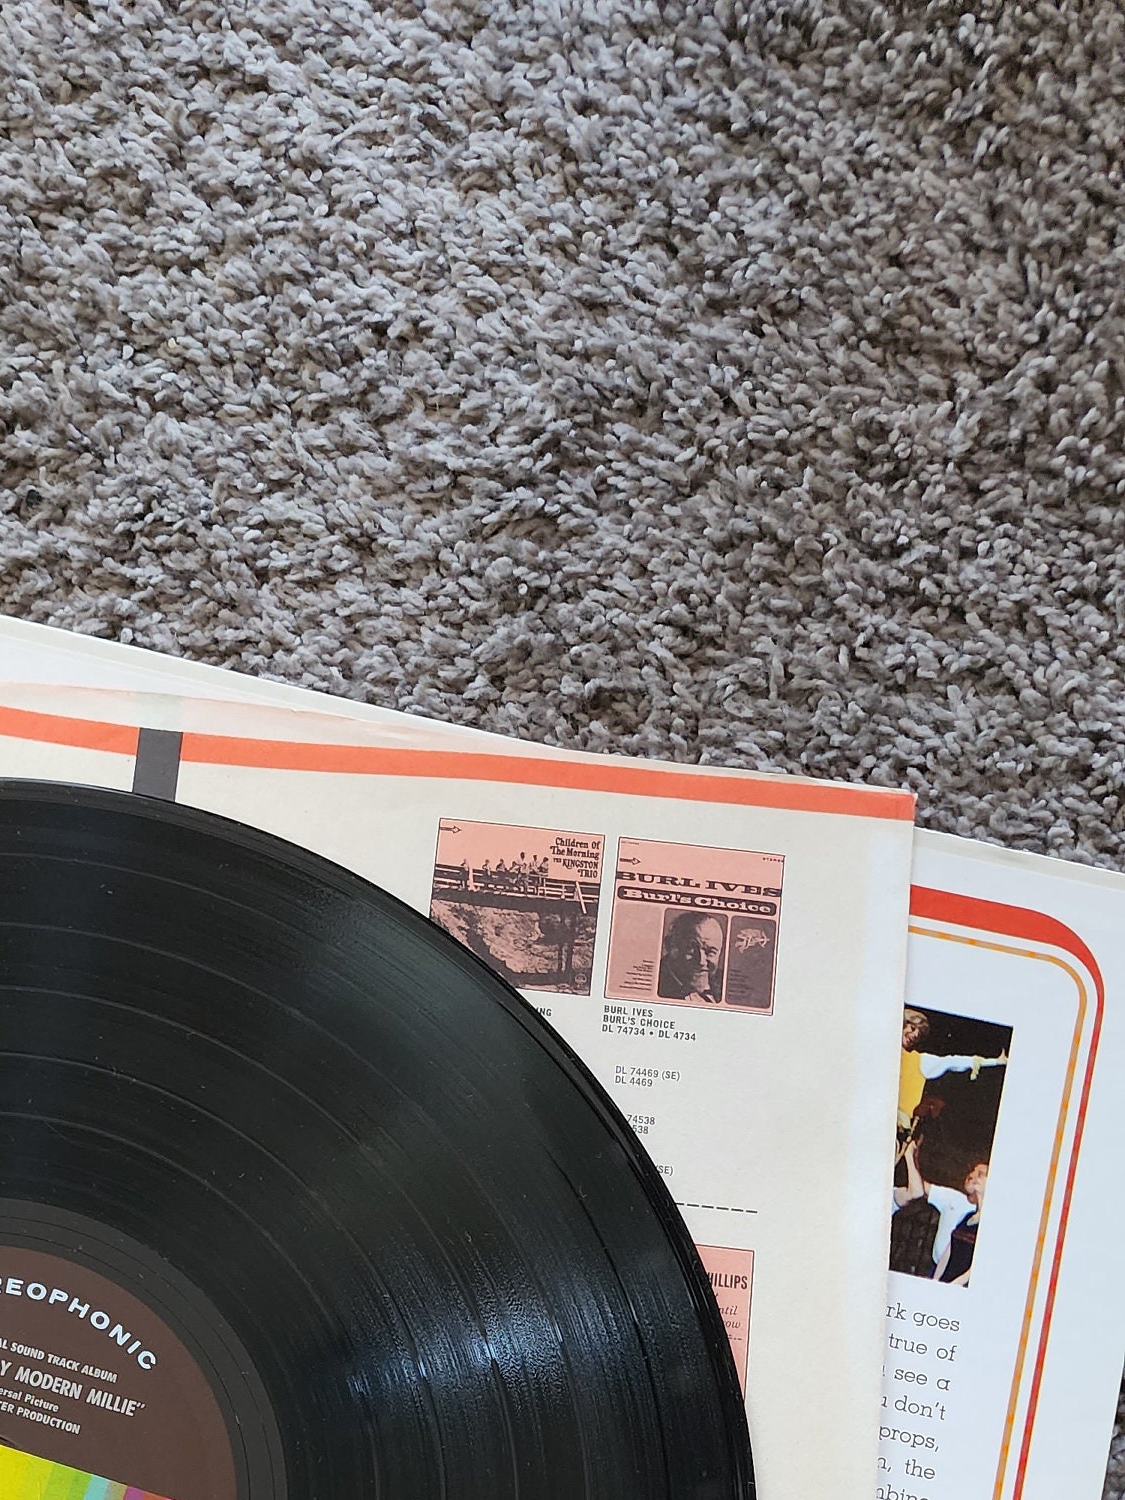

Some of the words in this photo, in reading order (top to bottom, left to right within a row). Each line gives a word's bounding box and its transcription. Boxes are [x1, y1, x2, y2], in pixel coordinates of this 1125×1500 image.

[556, 837, 588, 848] Children
[592, 841, 600, 849] Of
[550, 846, 565, 855] The
[566, 848, 599, 860] Morning
[563, 859, 598, 869] KINGSTON
[578, 869, 597, 878] TRIO
[616, 871, 700, 888] BURL
[705, 881, 782, 897] IVES
[624, 889, 691, 904] Burl's
[695, 897, 771, 913] Choice
[604, 1005, 628, 1015] BURL
[632, 1008, 653, 1017] IVES
[603, 1015, 636, 1026] BURL'S
[640, 1019, 675, 1029] CHOICE
[602, 1024, 613, 1032] DL
[617, 1026, 645, 1036] 74734
[658, 1030, 670, 1038] DL
[673, 1032, 696, 1041] 4734
[615, 1065, 627, 1075] DL
[630, 1067, 658, 1078] 74469
[662, 1071, 680, 1081] (SE)
[629, 1077, 653, 1087] 4469
[627, 1115, 655, 1125] 74538
[913, 1312, 961, 1332] goes
[889, 1333, 928, 1355] true
[936, 1345, 958, 1362] of
[10, 1342, 45, 1360] SOUND
[47, 1354, 81, 1372] TRACK
[81, 1364, 118, 1384] ALBUM
[894, 1367, 928, 1386] see
[14, 1366, 83, 1400] MODERN
[86, 1388, 146, 1418] MILLIE"
[24, 1392, 59, 1412] Picture
[893, 1395, 946, 1421] don't
[16, 1406, 81, 1434] PRODUCTION
[879, 1424, 940, 1453] props,
[904, 1459, 936, 1480] the
